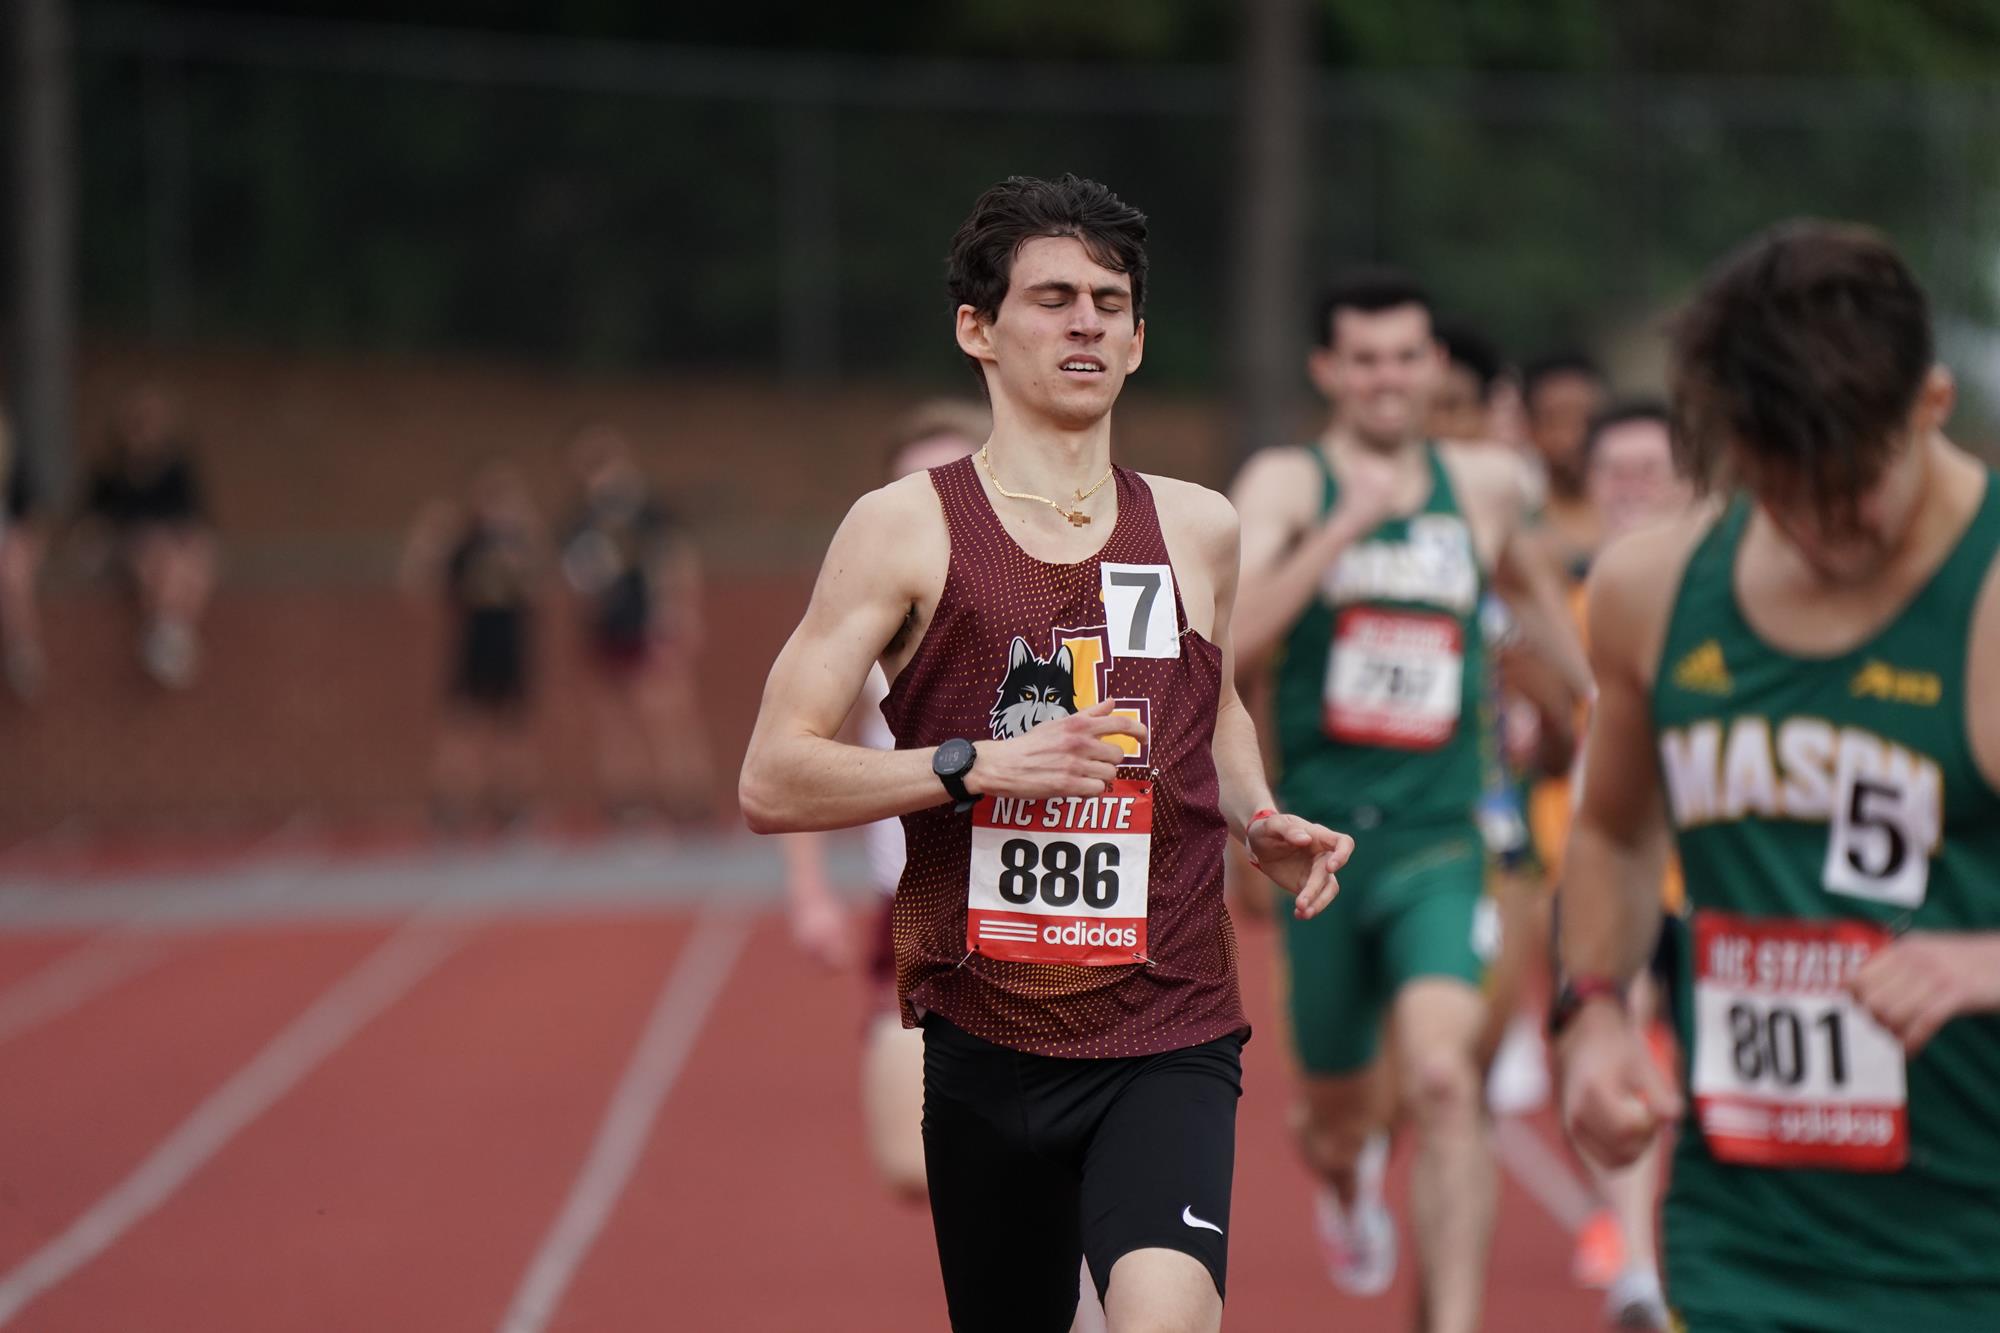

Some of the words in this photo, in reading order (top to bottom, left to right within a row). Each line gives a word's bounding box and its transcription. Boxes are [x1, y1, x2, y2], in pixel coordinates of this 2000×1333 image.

[1110, 571, 1161, 650] 7
[991, 796, 1036, 826] NC
[1042, 796, 1135, 830] STATE
[1848, 779, 1907, 880] 5
[999, 838, 1120, 910] 886
[1042, 921, 1137, 947] adidas
[1729, 1002, 1847, 1087] 801
